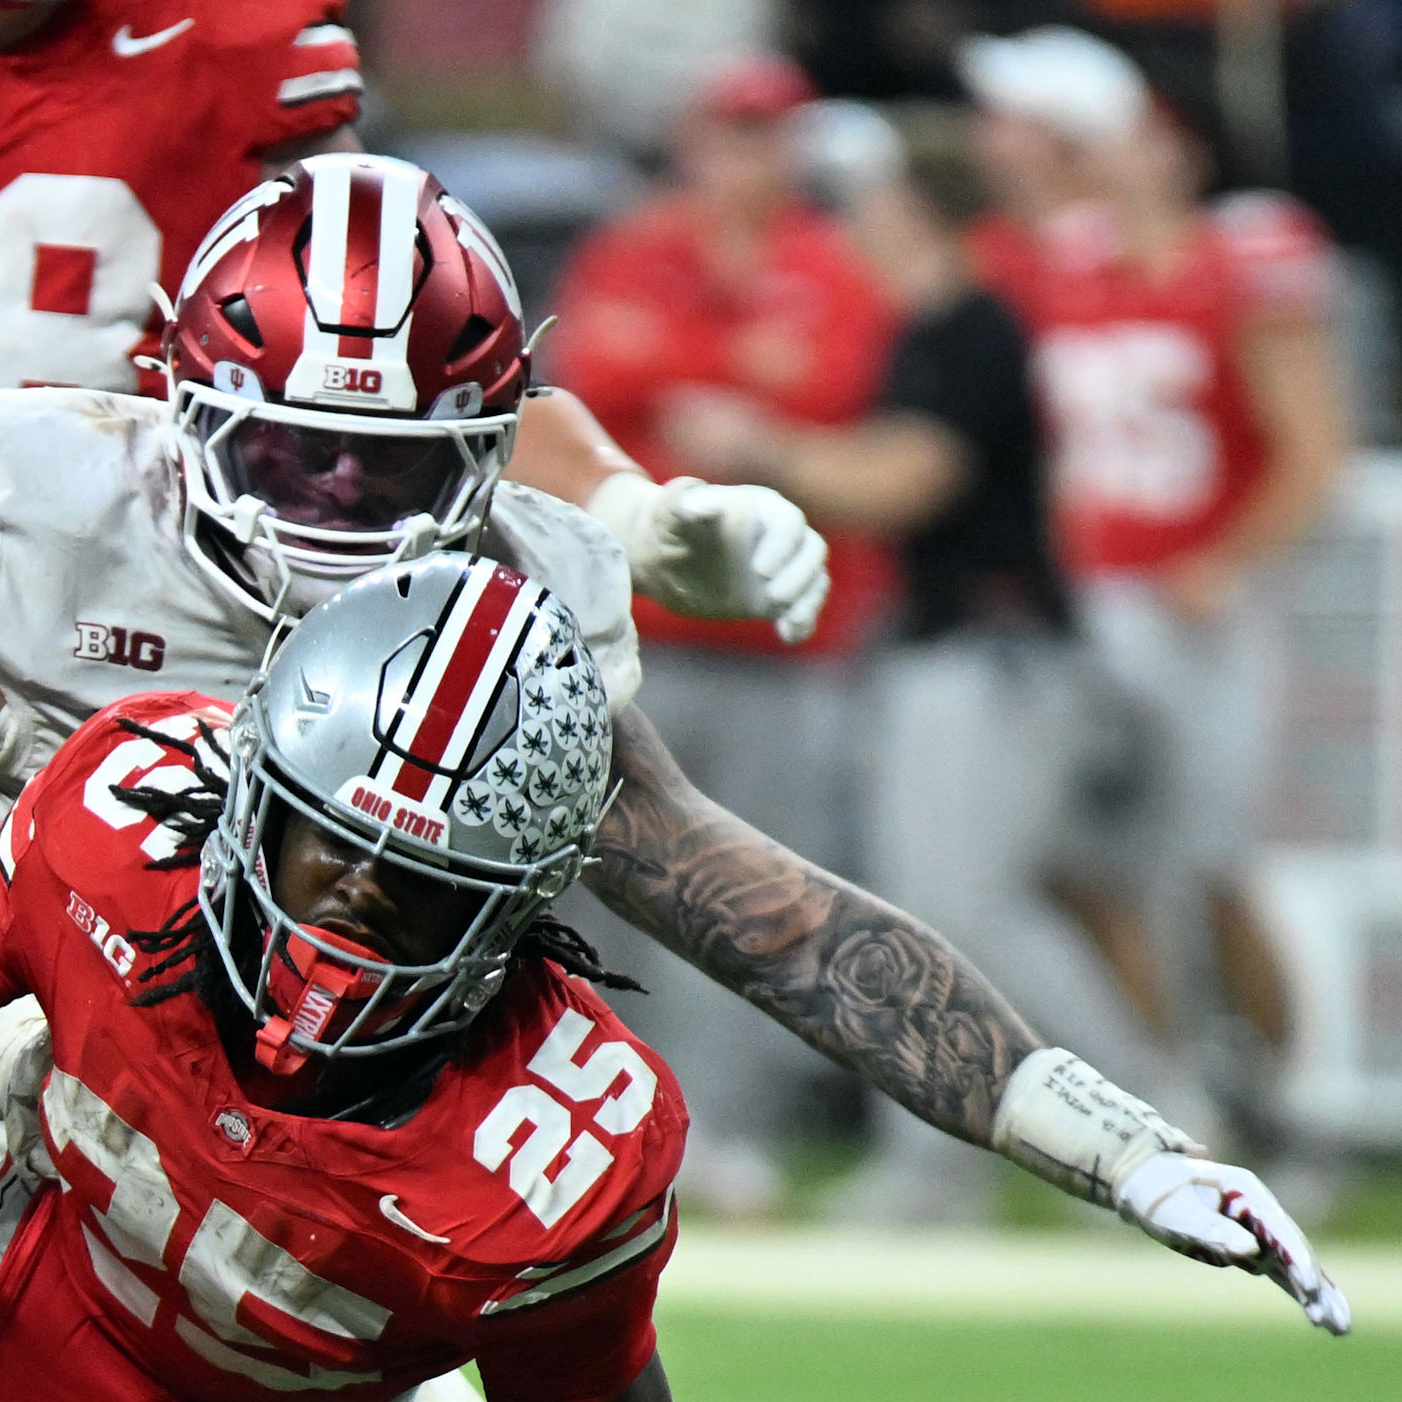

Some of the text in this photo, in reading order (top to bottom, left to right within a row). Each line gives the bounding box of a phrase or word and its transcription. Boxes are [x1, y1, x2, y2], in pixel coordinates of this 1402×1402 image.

[351, 786, 445, 845] OHIO STATE
[473, 1007, 658, 1230] 25
